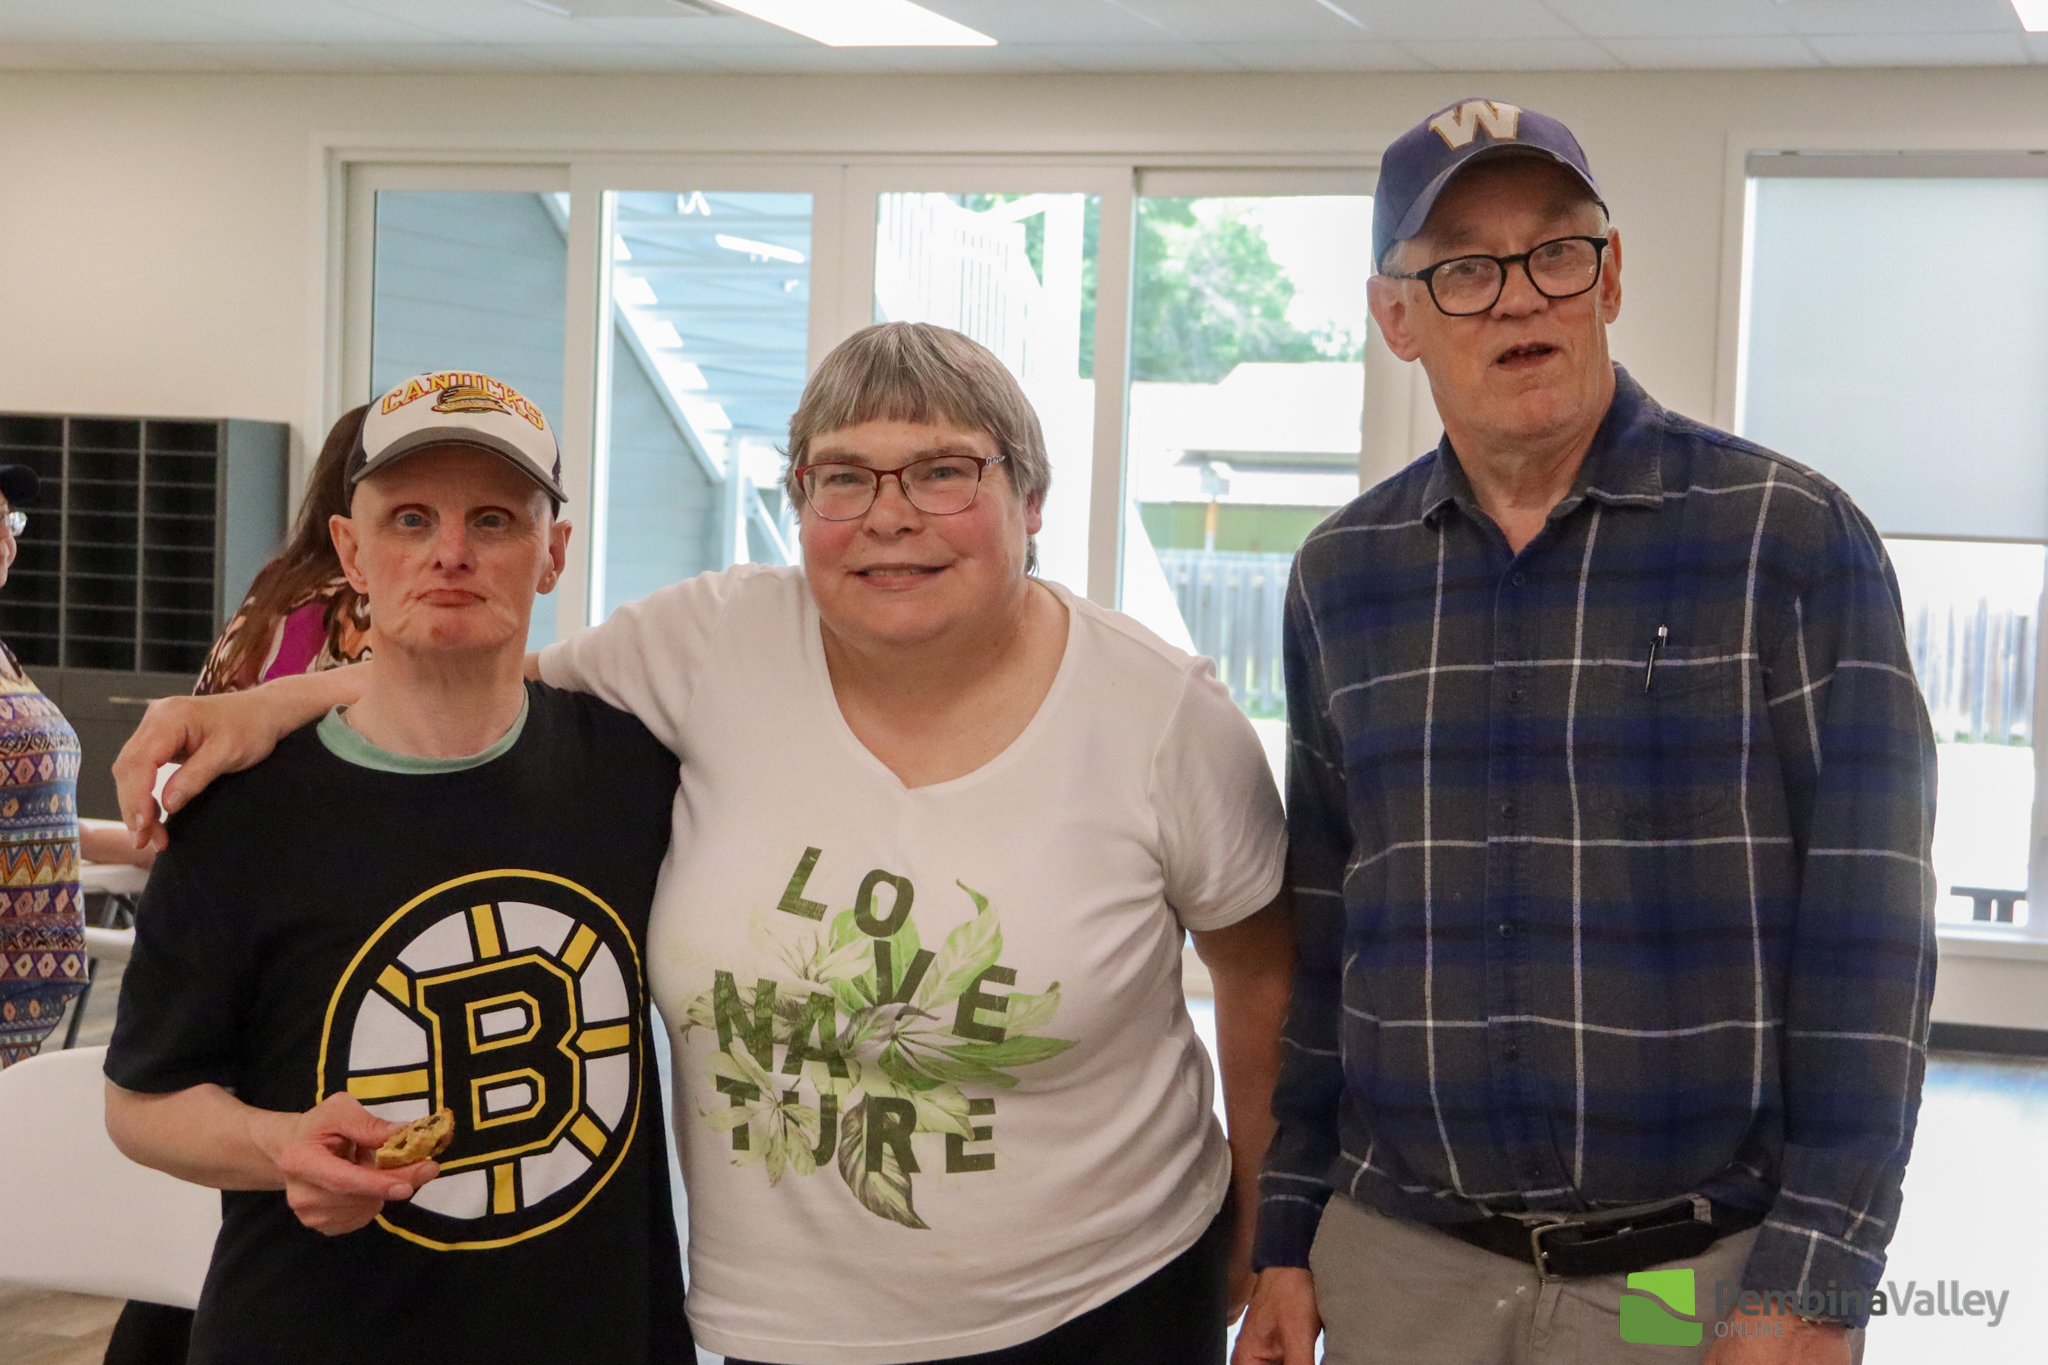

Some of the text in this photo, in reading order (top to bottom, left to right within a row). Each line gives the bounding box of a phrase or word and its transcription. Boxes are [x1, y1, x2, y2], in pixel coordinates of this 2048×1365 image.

[1428, 100, 1523, 150] W
[381, 373, 544, 431] CANUCKS
[776, 846, 1018, 1044] LOVE
[416, 954, 580, 1171] B
